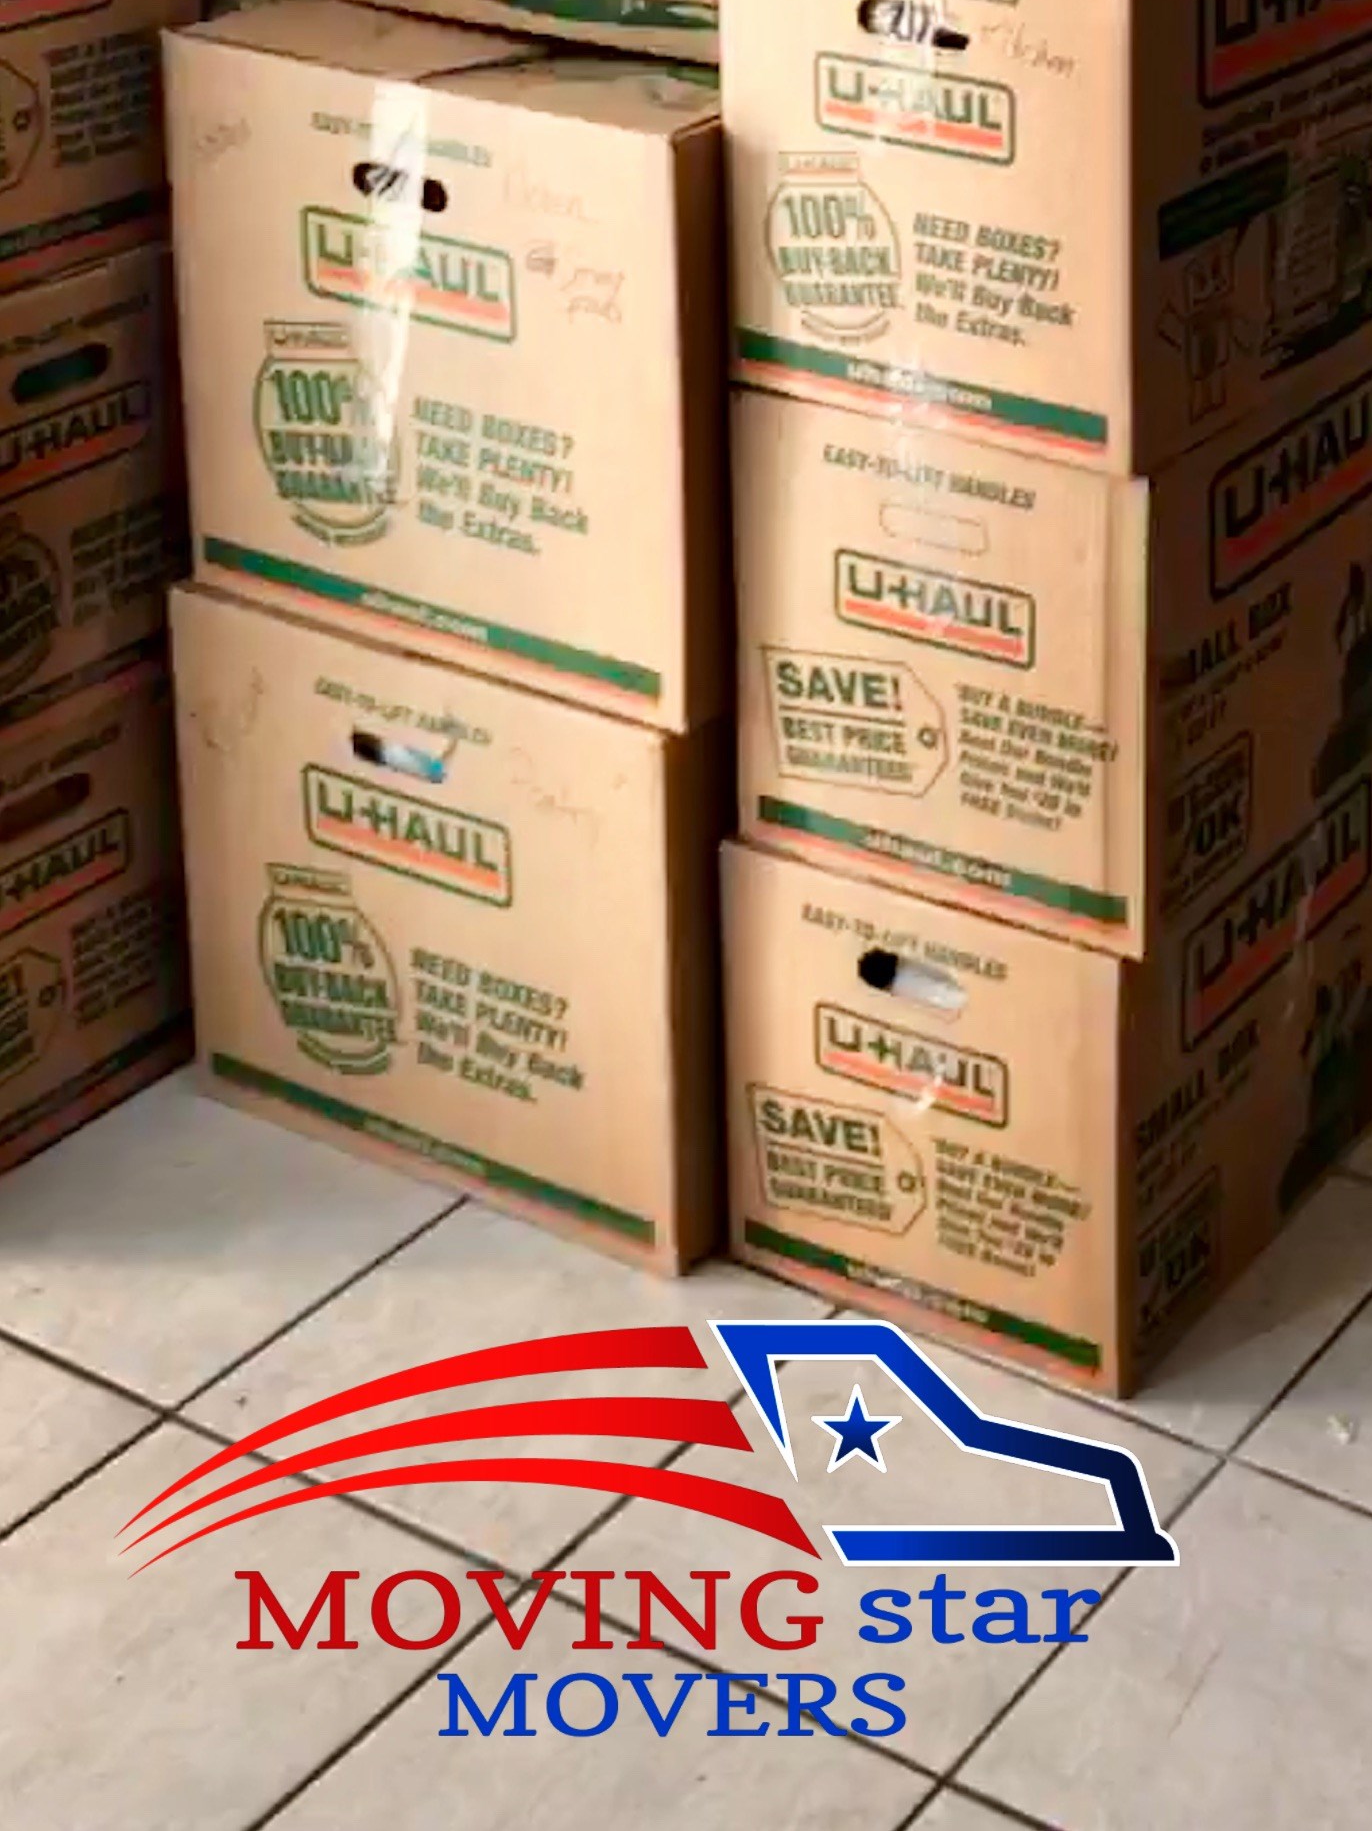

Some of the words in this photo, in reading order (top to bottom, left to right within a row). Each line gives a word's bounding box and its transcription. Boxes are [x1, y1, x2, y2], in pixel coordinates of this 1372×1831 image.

[826, 65, 1002, 131] U-HAUL
[781, 193, 875, 242] 100%
[913, 211, 969, 240] NEED
[975, 227, 1062, 263] BOXES?
[778, 245, 891, 277] BUY-BACK
[915, 243, 966, 272] TAKE
[973, 255, 1060, 291] PLENTY!
[916, 303, 948, 329] the
[954, 311, 1029, 347] Extras.
[972, 285, 1011, 317] Buy
[1018, 294, 1075, 328] Back
[413, 394, 472, 434] NEED
[479, 408, 576, 458] BOXES?
[415, 431, 470, 469] TAKE
[478, 444, 574, 495] PLENTY!
[823, 444, 943, 487] EASY-TO-LIFT
[949, 473, 1036, 510] HANDLES
[462, 512, 543, 556] Extras.
[479, 478, 523, 520] Buy
[530, 493, 590, 536] Back
[847, 564, 1024, 637] U-HAUL
[777, 661, 903, 712] SAVE!
[782, 715, 837, 746] BEST
[843, 724, 908, 756] PRICE
[316, 780, 499, 872] U-HAUL
[1199, 810, 1361, 992] U-HAUL
[274, 907, 376, 968] 100%
[410, 946, 471, 988] NEED
[478, 964, 570, 1020] BOXES?
[413, 981, 468, 1019] TAKE
[476, 997, 568, 1051] PLENTY!
[459, 1058, 540, 1104] Extras.
[825, 1015, 997, 1098] U-HAUL
[760, 1099, 883, 1157] SAVE!
[766, 1150, 819, 1182] BEST
[823, 1161, 885, 1195] PRICE
